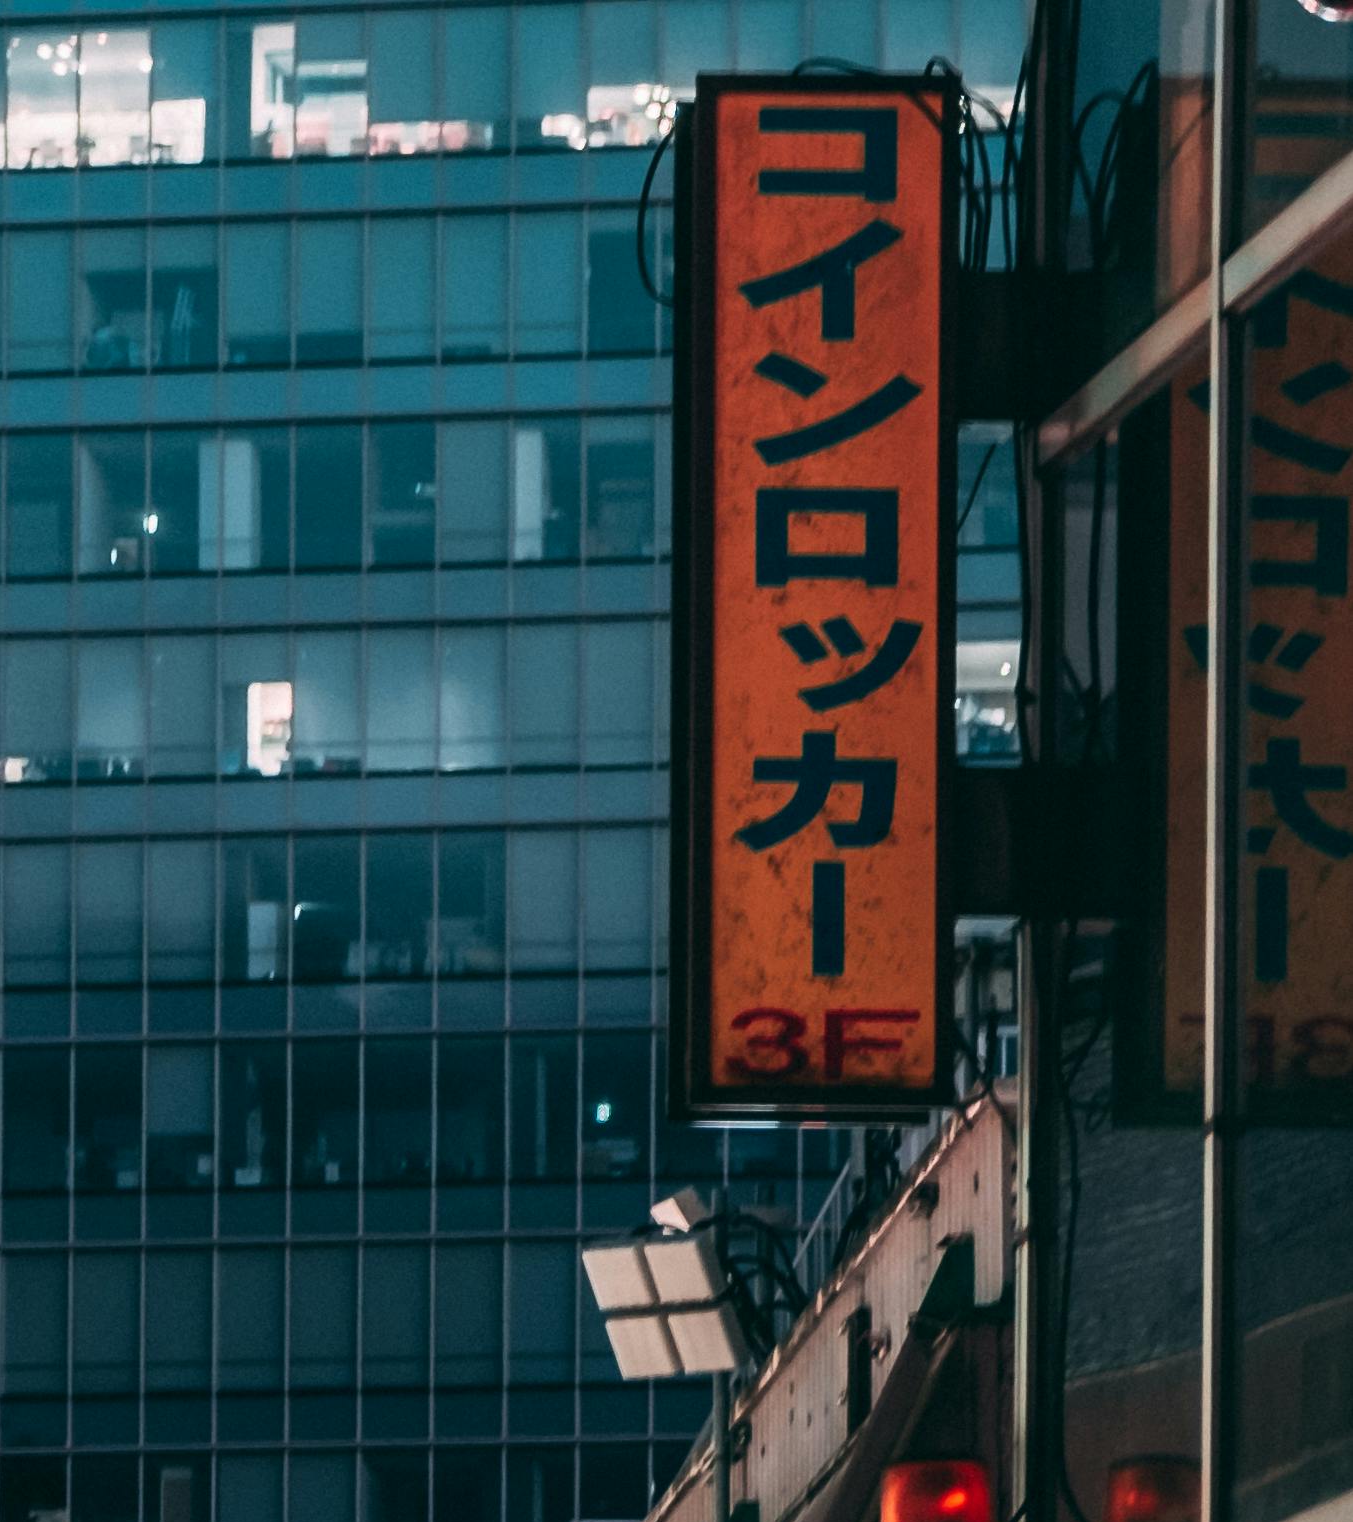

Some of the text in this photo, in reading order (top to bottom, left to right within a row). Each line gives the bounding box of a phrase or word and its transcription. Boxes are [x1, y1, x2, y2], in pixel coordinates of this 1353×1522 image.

[736, 106, 922, 978] コインロッカー
[727, 1007, 920, 1084] 3F
